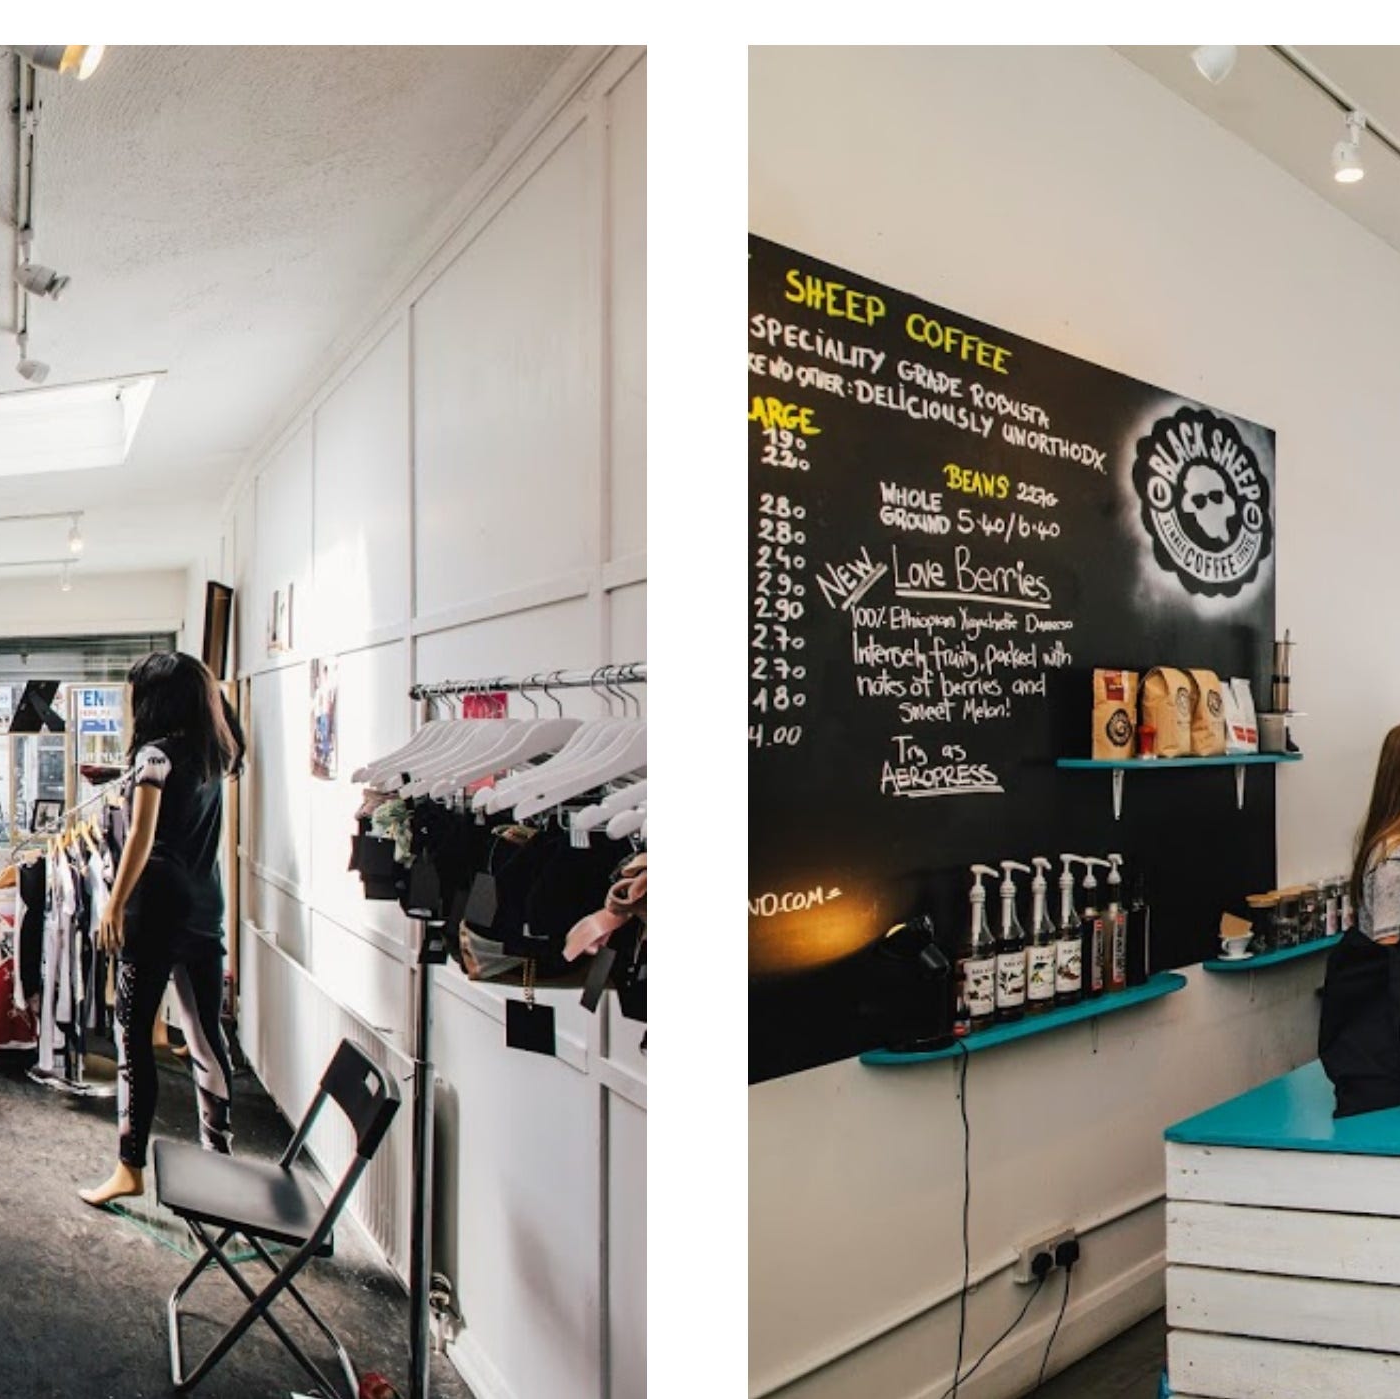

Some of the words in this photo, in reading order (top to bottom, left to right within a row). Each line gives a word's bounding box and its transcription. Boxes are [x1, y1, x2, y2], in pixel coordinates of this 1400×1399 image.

[785, 269, 887, 327] SHEEP
[905, 312, 1014, 376] COFFEE
[897, 359, 964, 399] GRADE
[1148, 421, 1210, 486] BLACK
[1209, 428, 1262, 501] SHEEP
[879, 481, 943, 512] WHOLE
[942, 462, 1011, 499] BEANS
[880, 505, 950, 535] GROUND
[892, 543, 947, 590] Love
[954, 544, 1052, 602] Berries
[1182, 548, 1238, 580] COFFEE
[889, 606, 956, 637] Ethiopian
[852, 630, 930, 673] Intensely
[1042, 640, 1073, 669] with
[856, 668, 907, 698] notes
[910, 669, 935, 698] of
[939, 672, 1002, 698] berries
[1011, 672, 1047, 697] and
[899, 697, 956, 724] sweet
[890, 734, 928, 767] Try
[941, 743, 967, 762] as
[879, 760, 1000, 795] AEROPRESS
